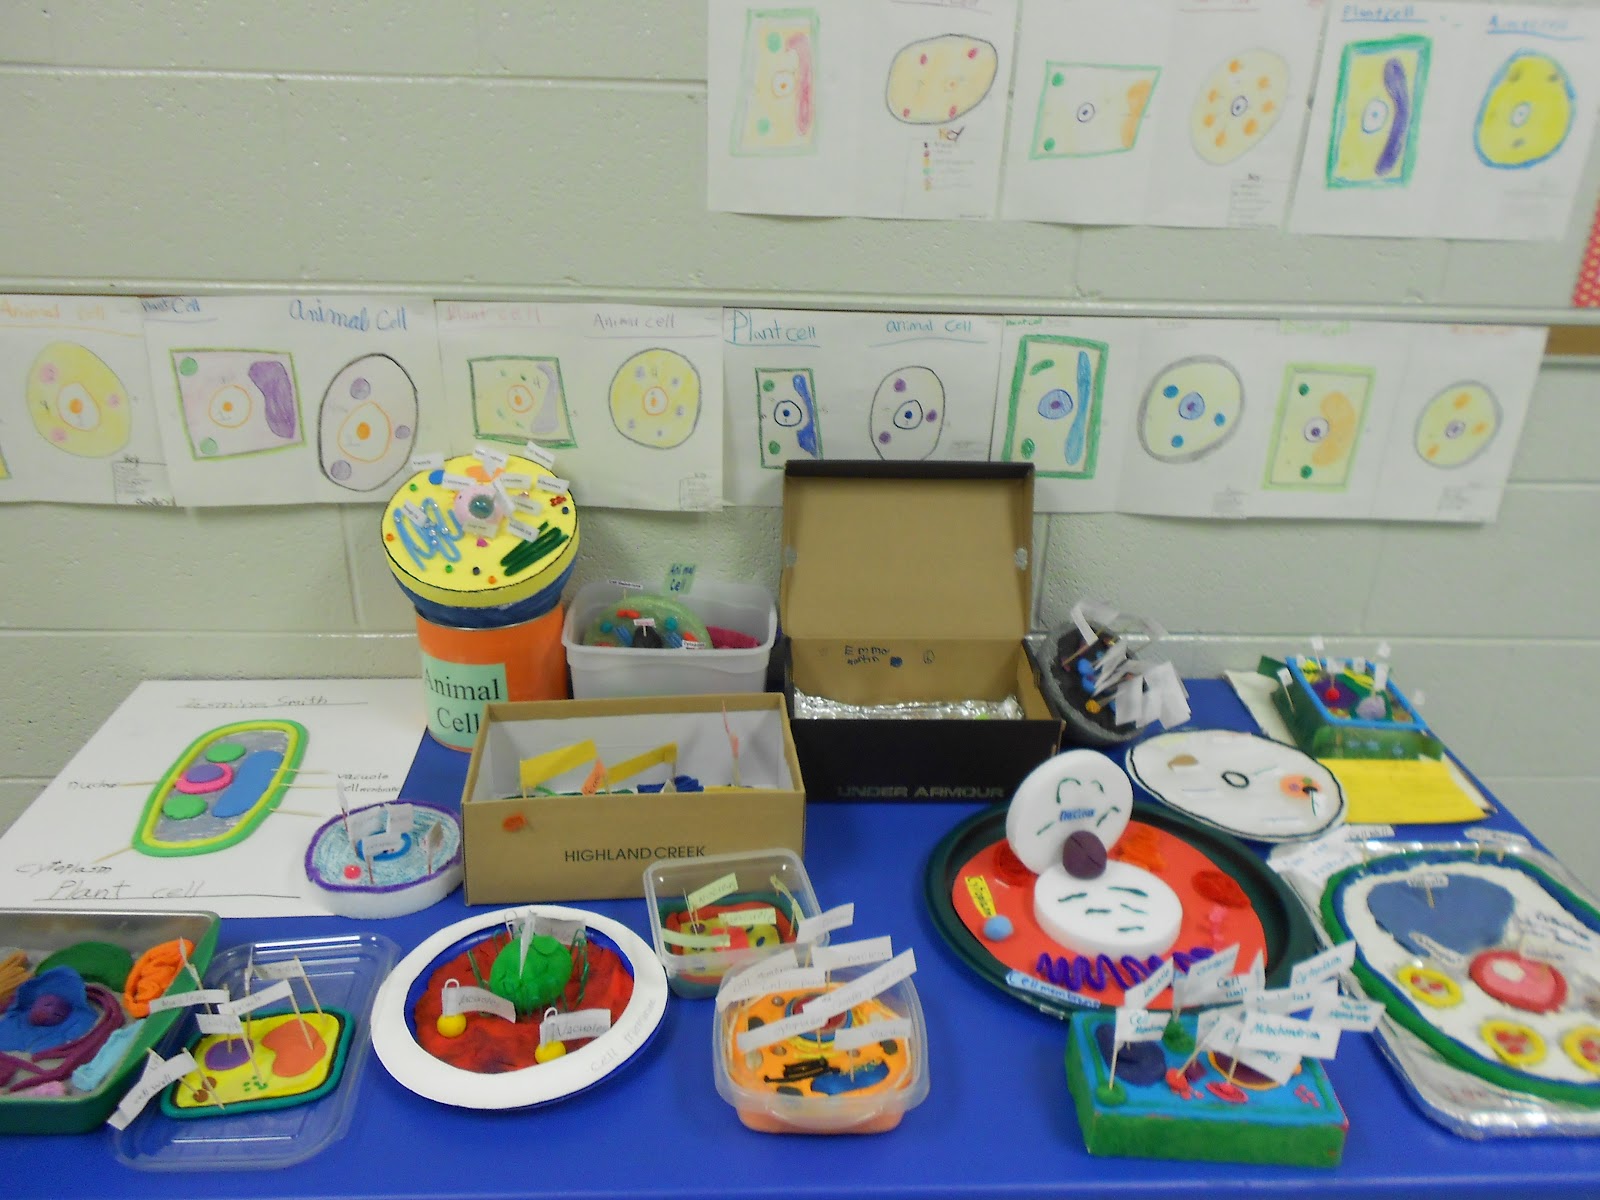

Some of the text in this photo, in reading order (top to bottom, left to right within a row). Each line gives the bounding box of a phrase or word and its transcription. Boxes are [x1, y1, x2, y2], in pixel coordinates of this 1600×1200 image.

[733, 308, 782, 344] Plant
[425, 667, 501, 702] Animal
[436, 706, 480, 735] Cell
[836, 786, 1005, 799] UNDER ARMOUR
[564, 845, 706, 863] HIGHLAND CREEK
[48, 879, 132, 901] Plant
